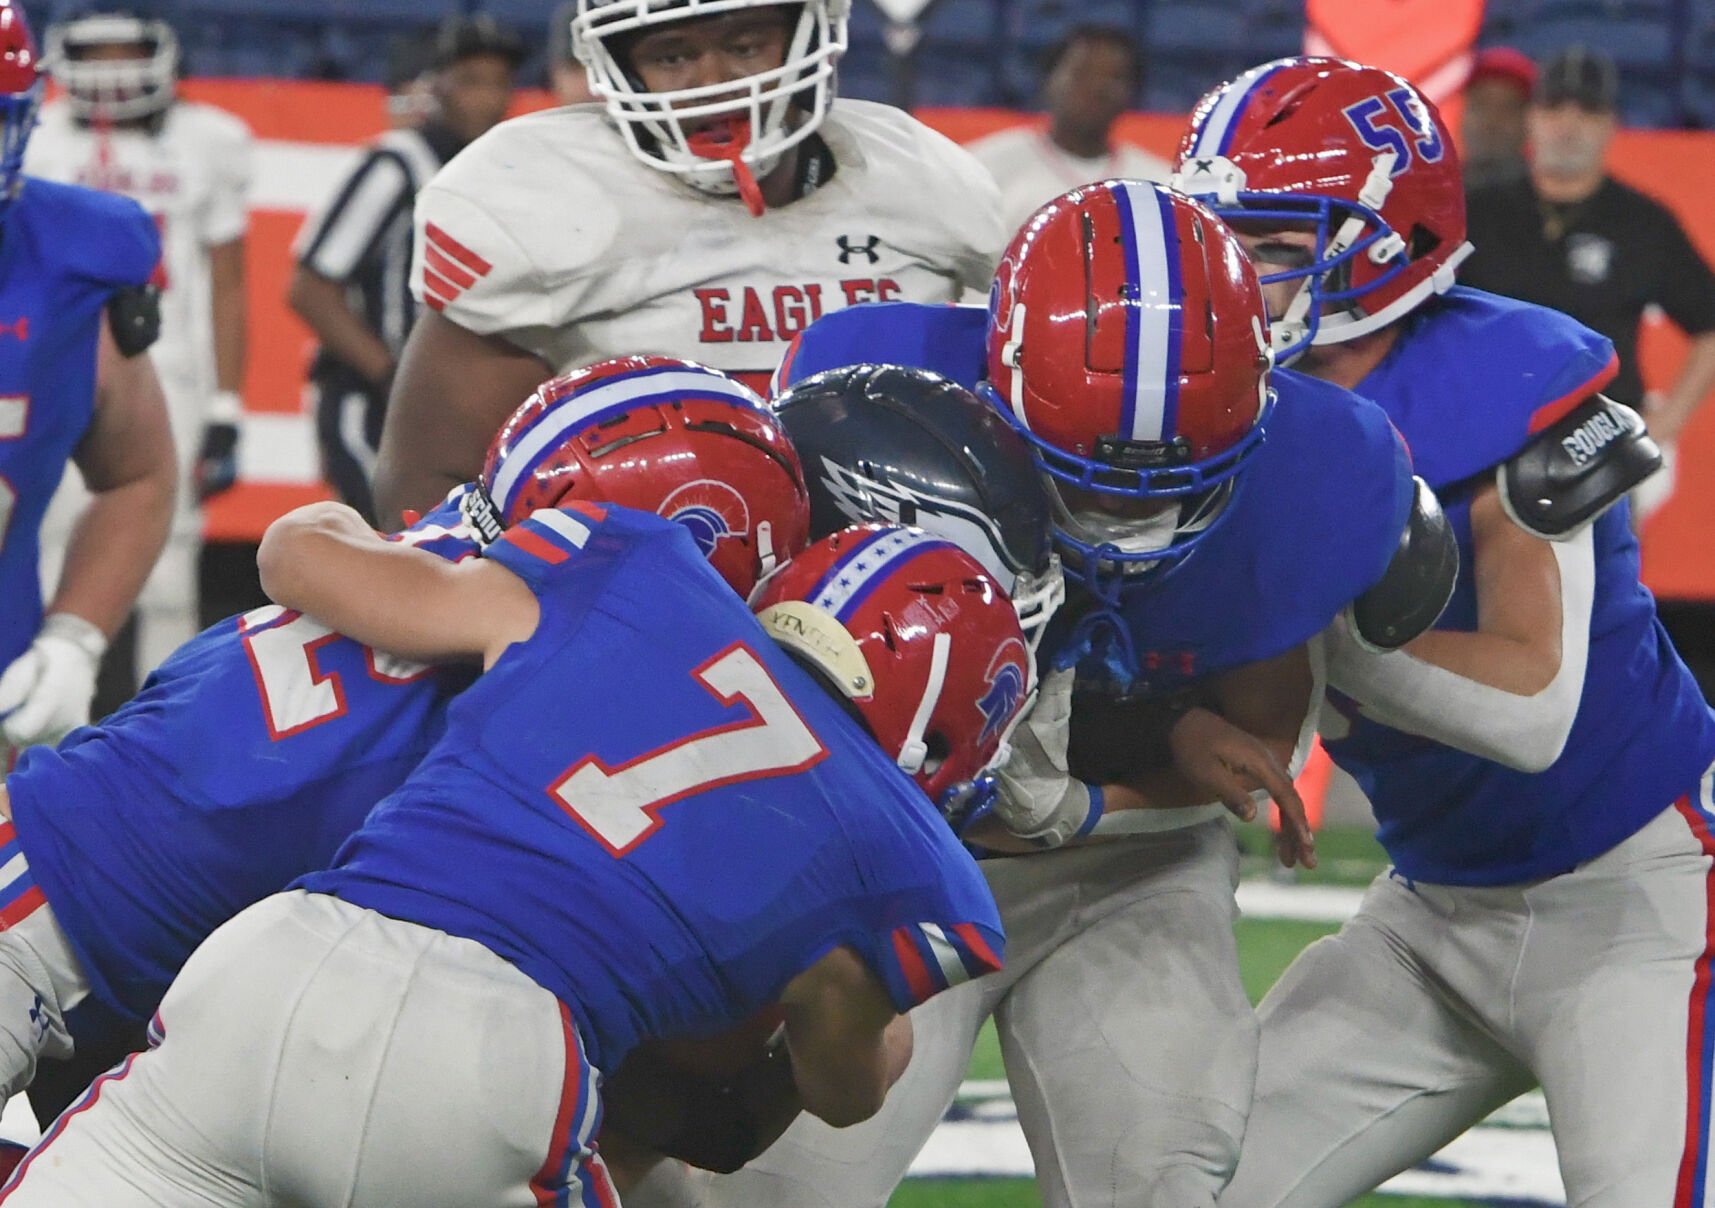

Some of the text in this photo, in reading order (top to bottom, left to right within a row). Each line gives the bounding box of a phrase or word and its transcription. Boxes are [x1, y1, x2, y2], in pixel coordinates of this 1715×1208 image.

[1341, 86, 1445, 178] 55
[1561, 405, 1636, 466] DOUGLA
[466, 488, 503, 541] schu
[546, 640, 830, 859] 7
